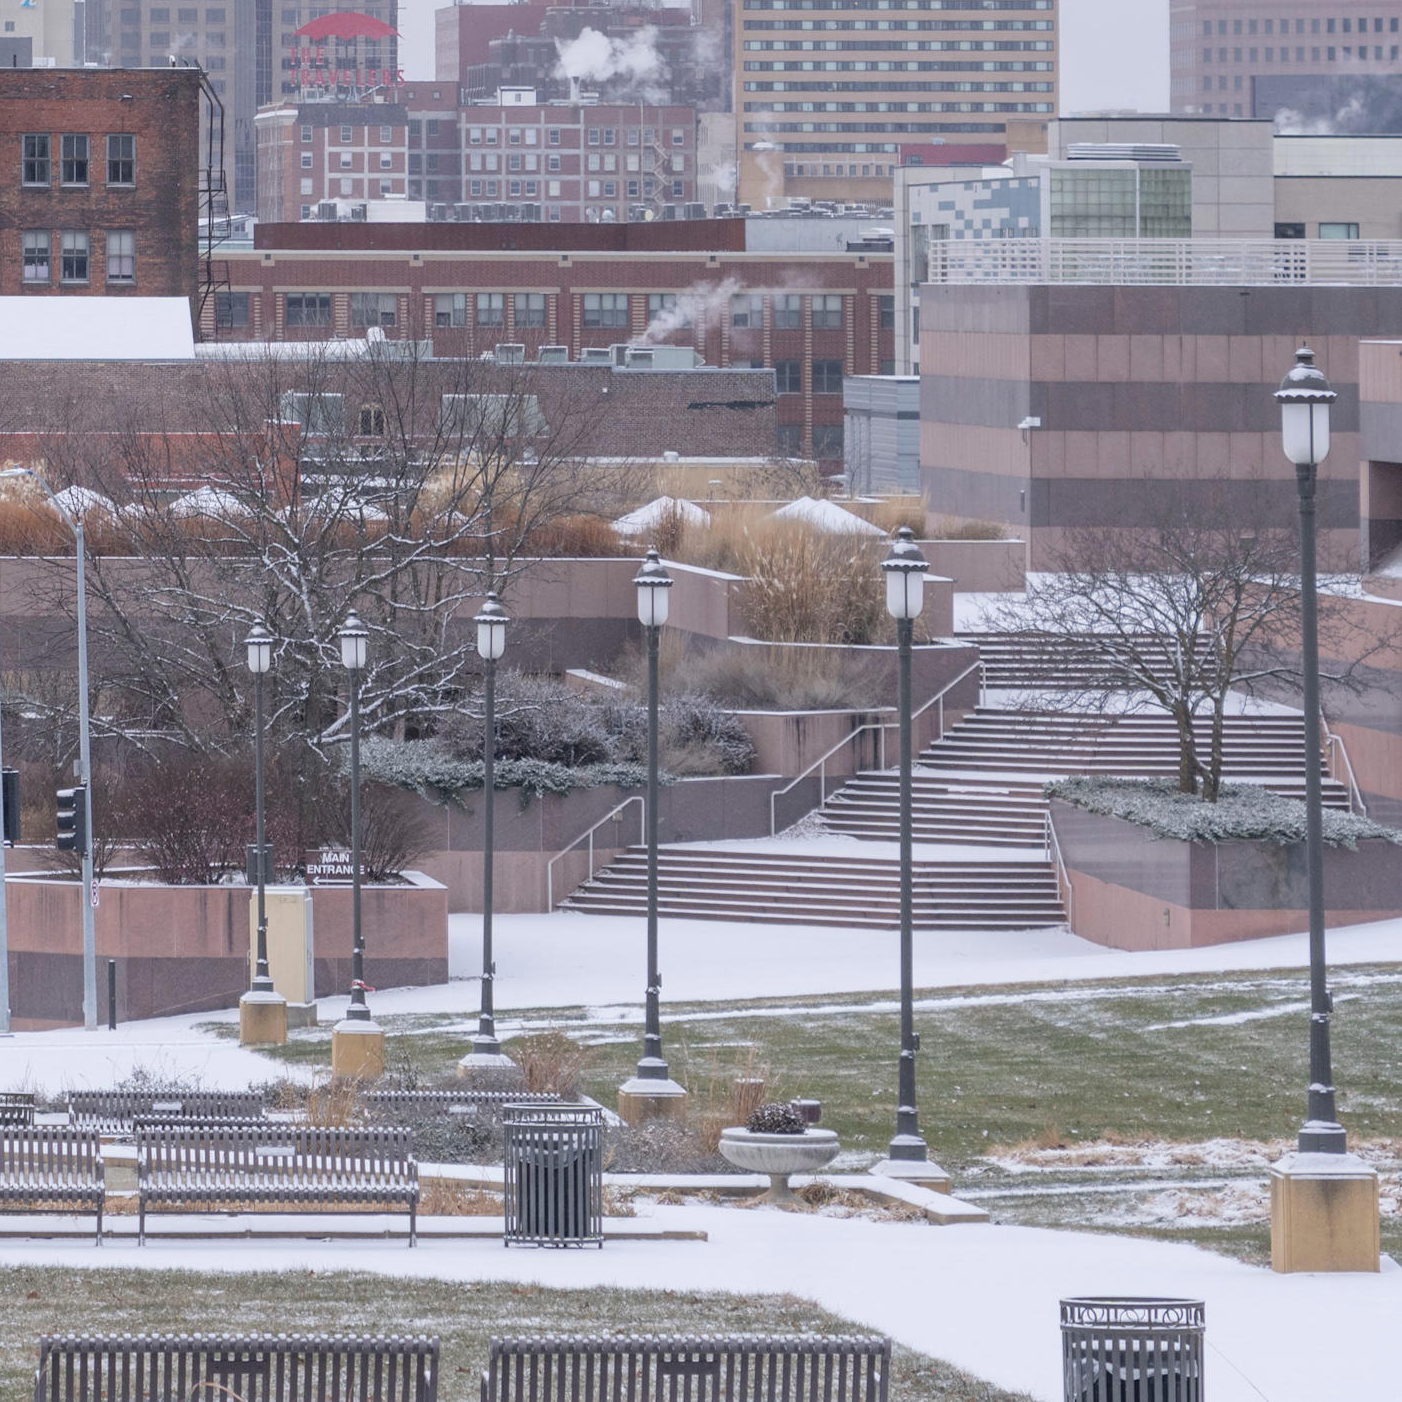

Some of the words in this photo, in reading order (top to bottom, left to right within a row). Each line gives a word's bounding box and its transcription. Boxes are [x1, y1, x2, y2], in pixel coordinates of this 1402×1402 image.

[289, 46, 324, 65] THE
[289, 69, 405, 87] TRAVELERS
[322, 853, 350, 864] MAIN
[307, 864, 365, 875] ENTRANE
